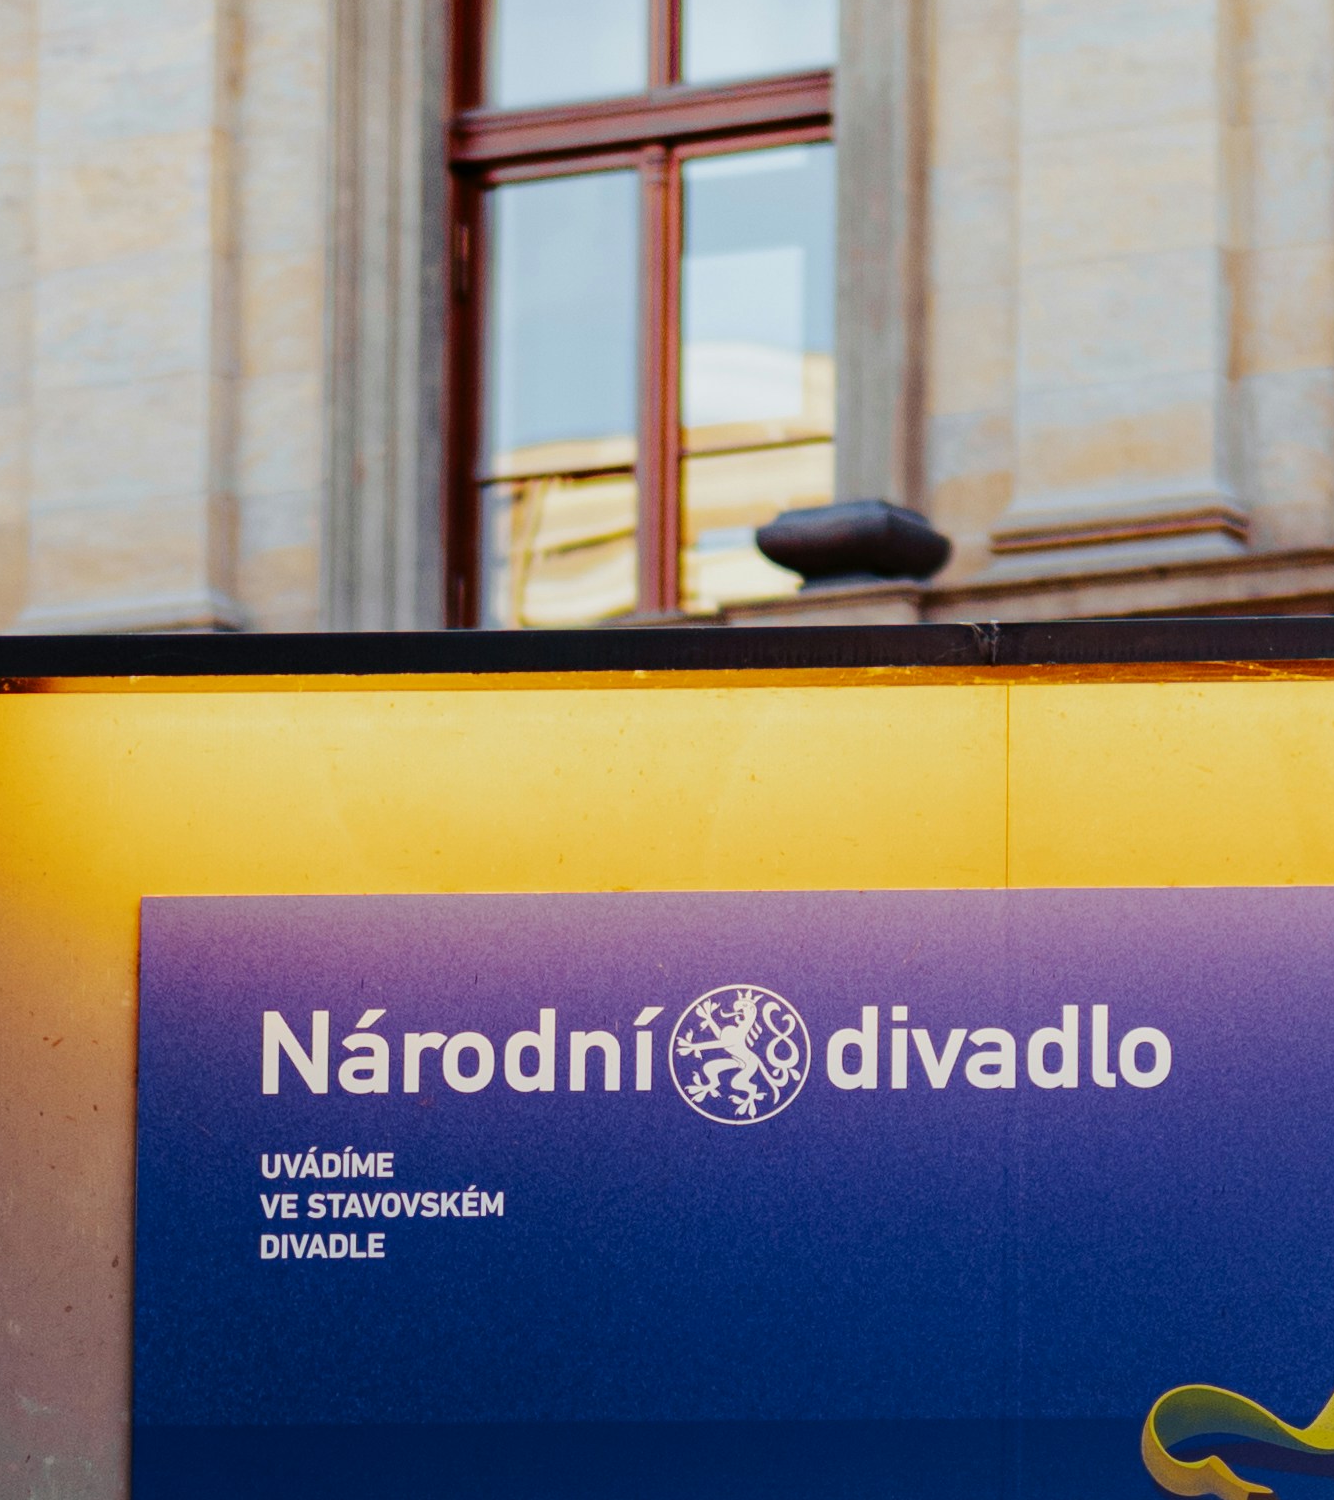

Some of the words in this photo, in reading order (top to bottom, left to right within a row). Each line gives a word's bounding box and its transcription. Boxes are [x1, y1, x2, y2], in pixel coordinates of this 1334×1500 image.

[263, 1006, 664, 1094] Národní
[827, 1004, 1171, 1090] divadlo
[262, 1146, 394, 1179] UVÁDÍME
[260, 1194, 298, 1219] VE
[307, 1185, 504, 1218] STAVOVSKÉM
[261, 1233, 385, 1259] DIVADLE
